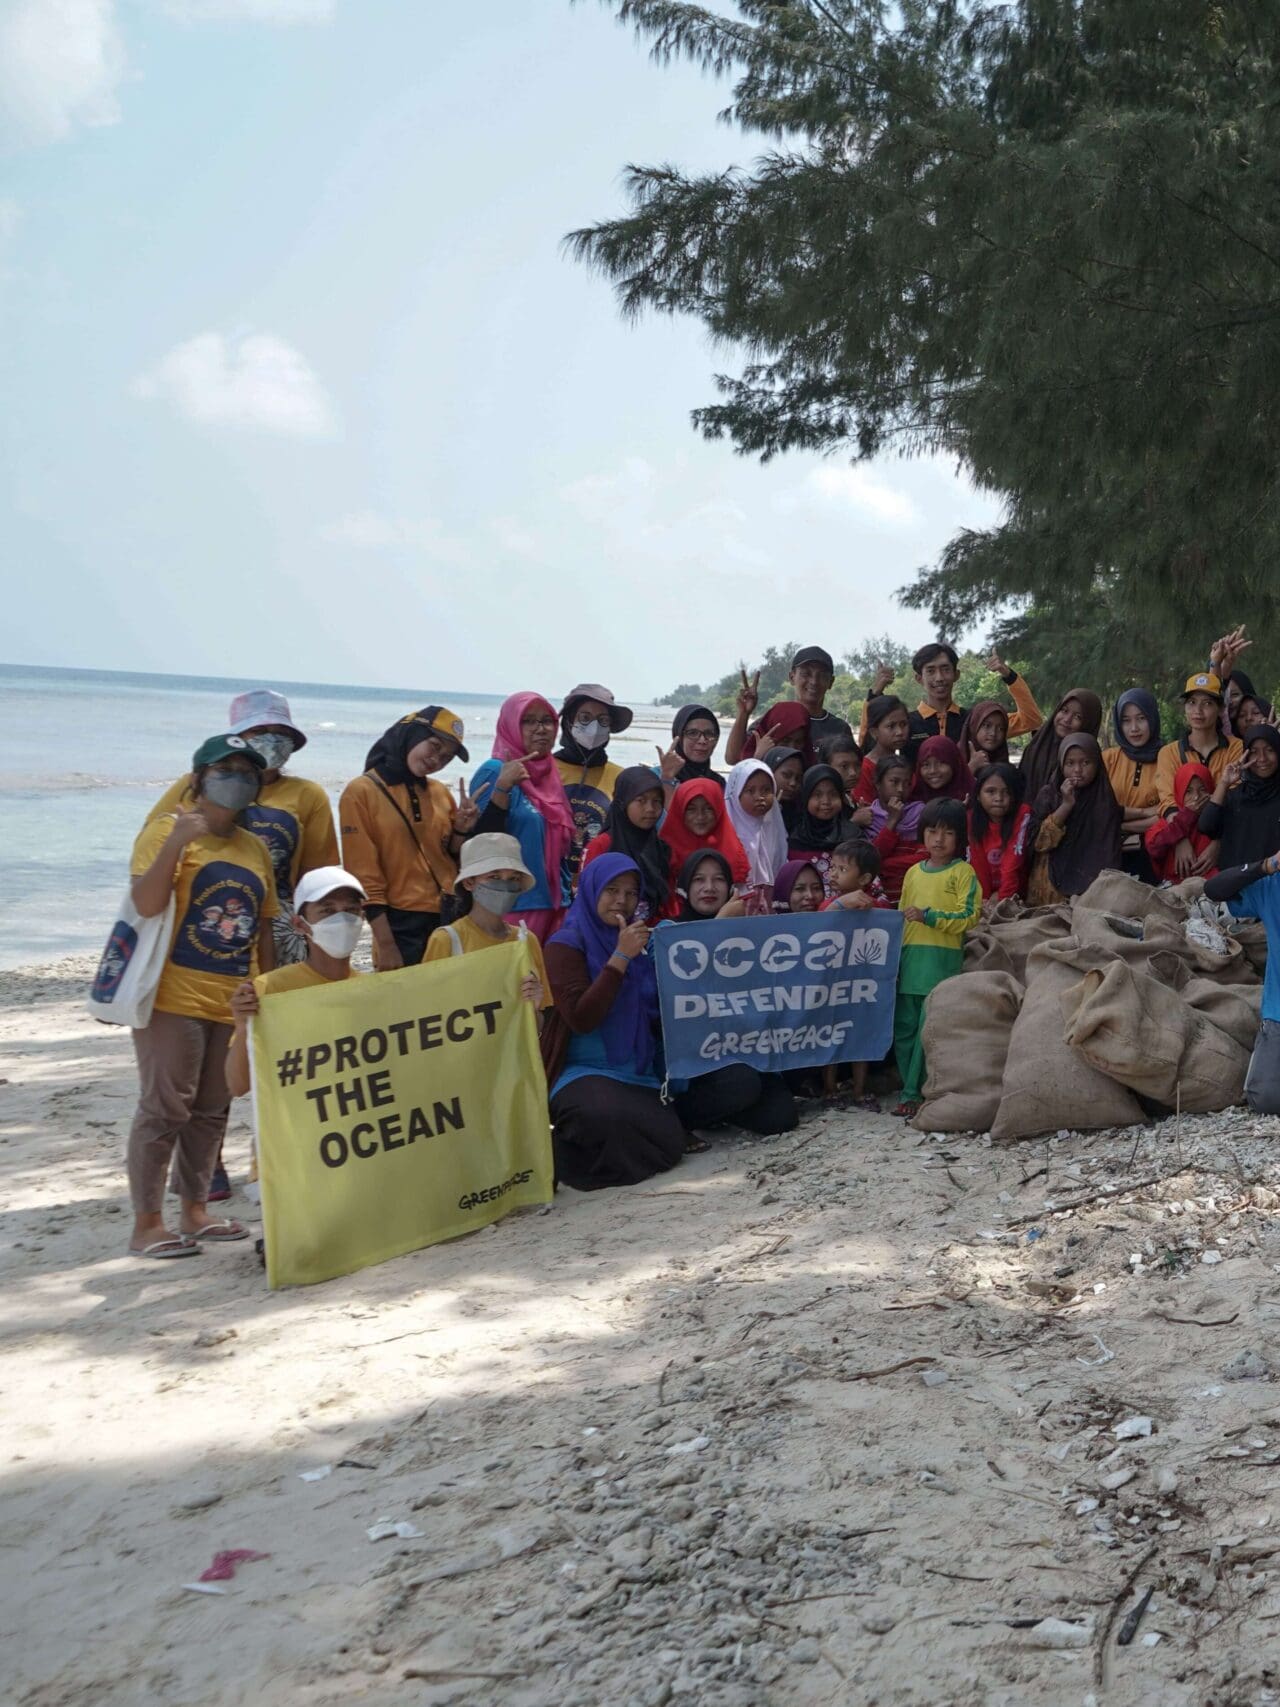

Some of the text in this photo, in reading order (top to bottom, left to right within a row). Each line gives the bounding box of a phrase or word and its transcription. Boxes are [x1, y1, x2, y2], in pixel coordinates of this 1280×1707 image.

[673, 978, 879, 1020] DEFENDER
[276, 1000, 503, 1087] #PROTECT
[700, 1020, 854, 1061] GREENPEACE
[305, 1069, 396, 1123] THE
[319, 1096, 466, 1169] OCEAN
